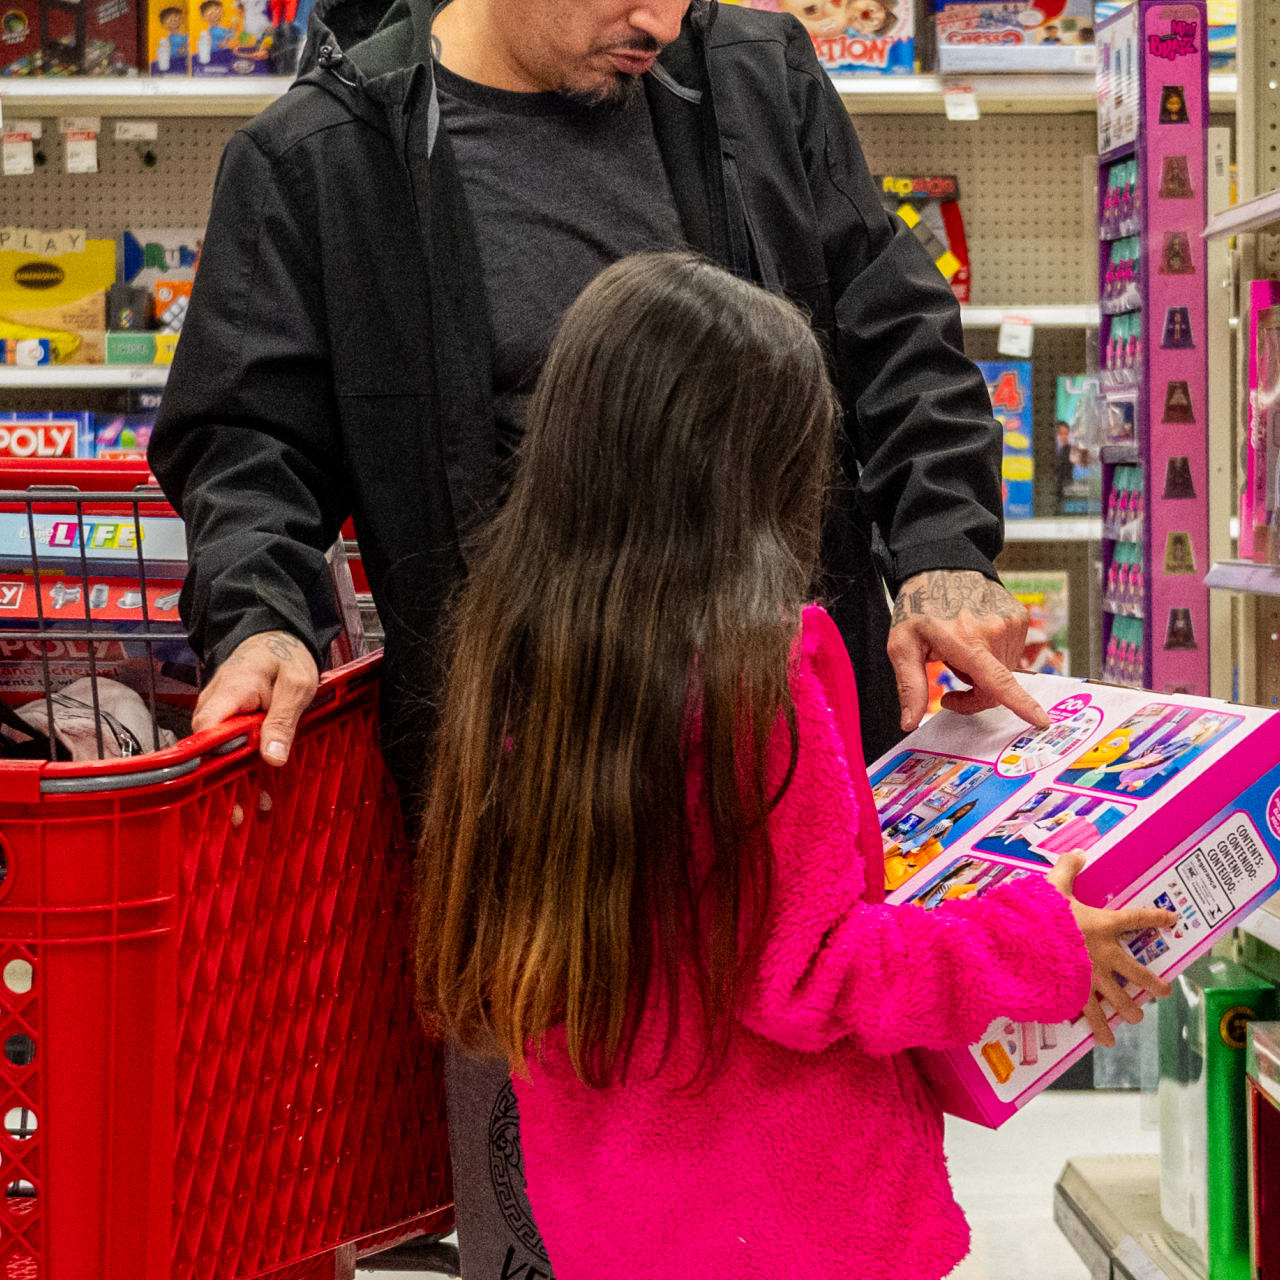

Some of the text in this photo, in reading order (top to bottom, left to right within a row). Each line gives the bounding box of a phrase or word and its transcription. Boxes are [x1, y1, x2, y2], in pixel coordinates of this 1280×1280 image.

[1226, 832, 1257, 882] CONTENIDO:
[1235, 824, 1265, 869] CONTENTS:
[1207, 848, 1237, 895] CONTEÚDO:
